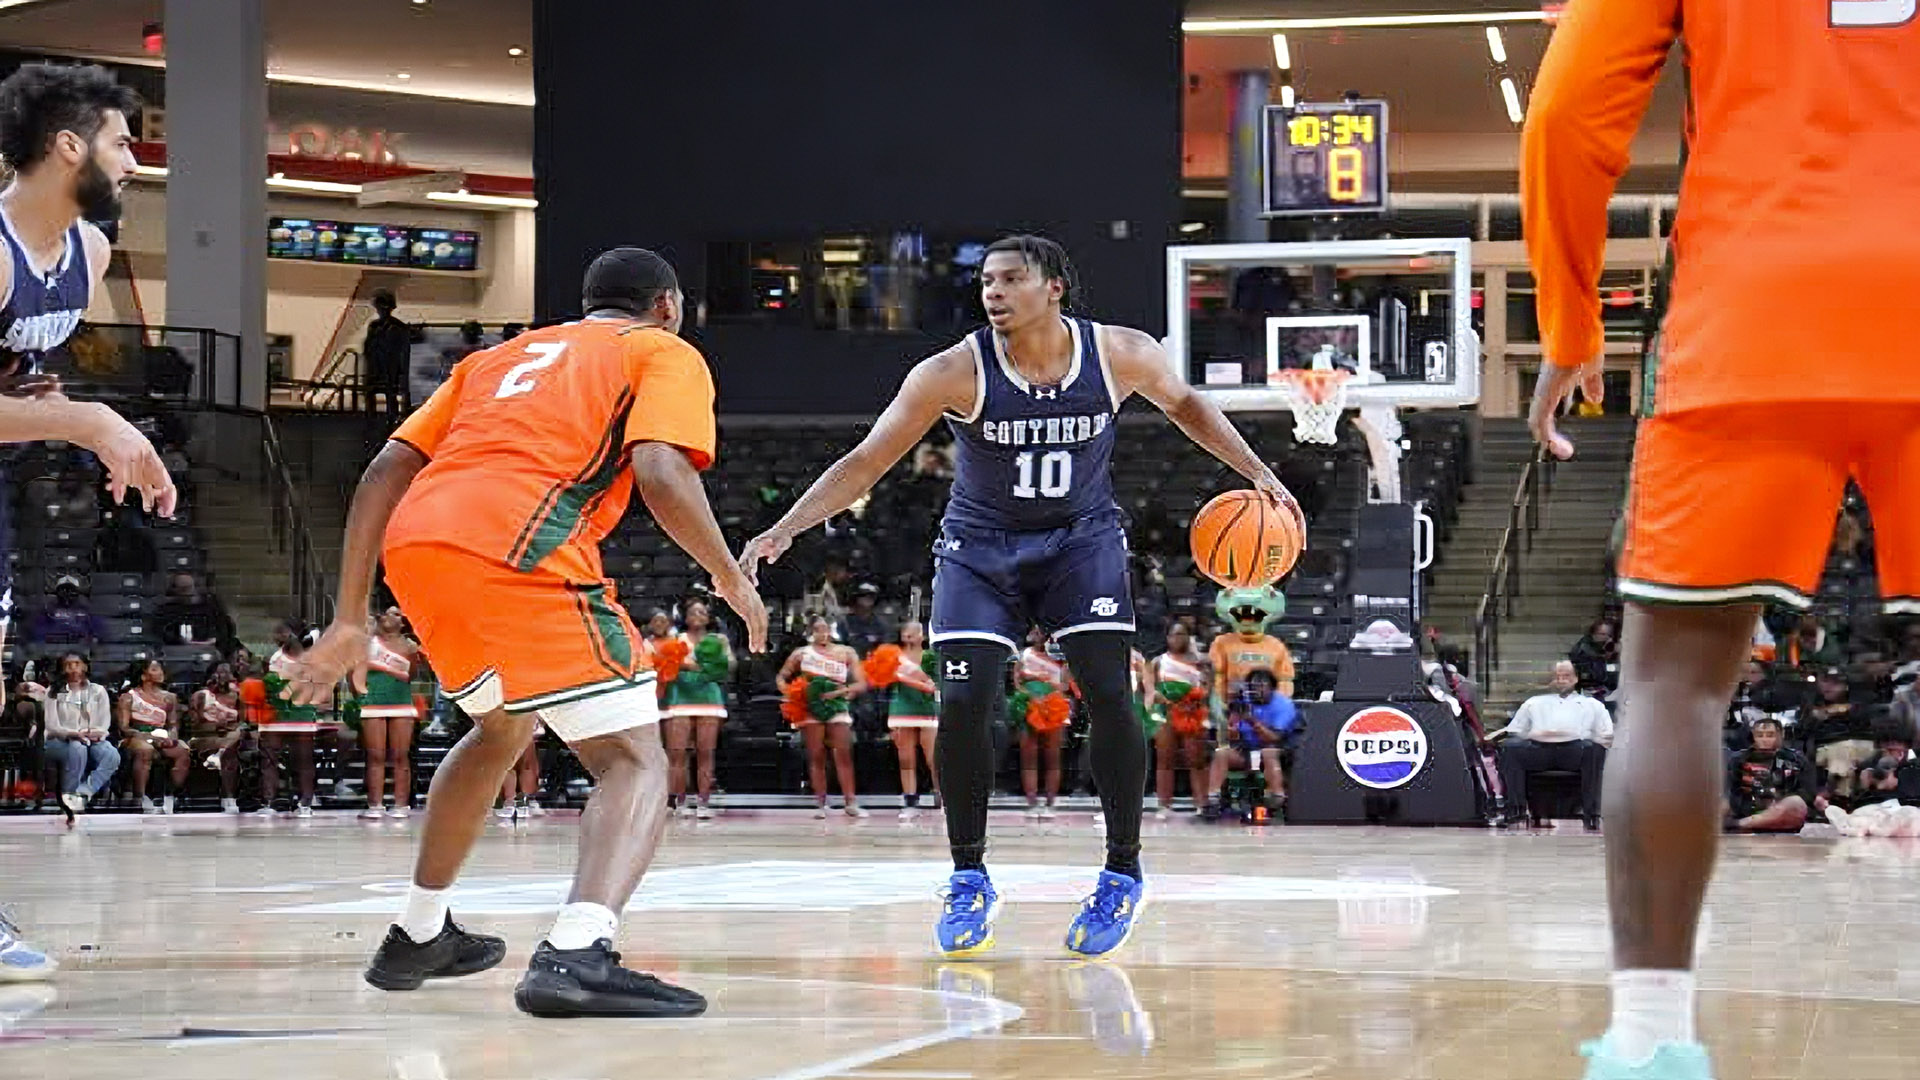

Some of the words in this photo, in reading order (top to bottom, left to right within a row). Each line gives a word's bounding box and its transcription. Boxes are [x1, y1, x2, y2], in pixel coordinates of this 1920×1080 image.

[1287, 115, 1374, 146] 10:34
[1329, 149, 1363, 200] 8
[494, 341, 568, 399] 2
[1013, 450, 1072, 498] 10
[1344, 739, 1419, 754] PEPSI
